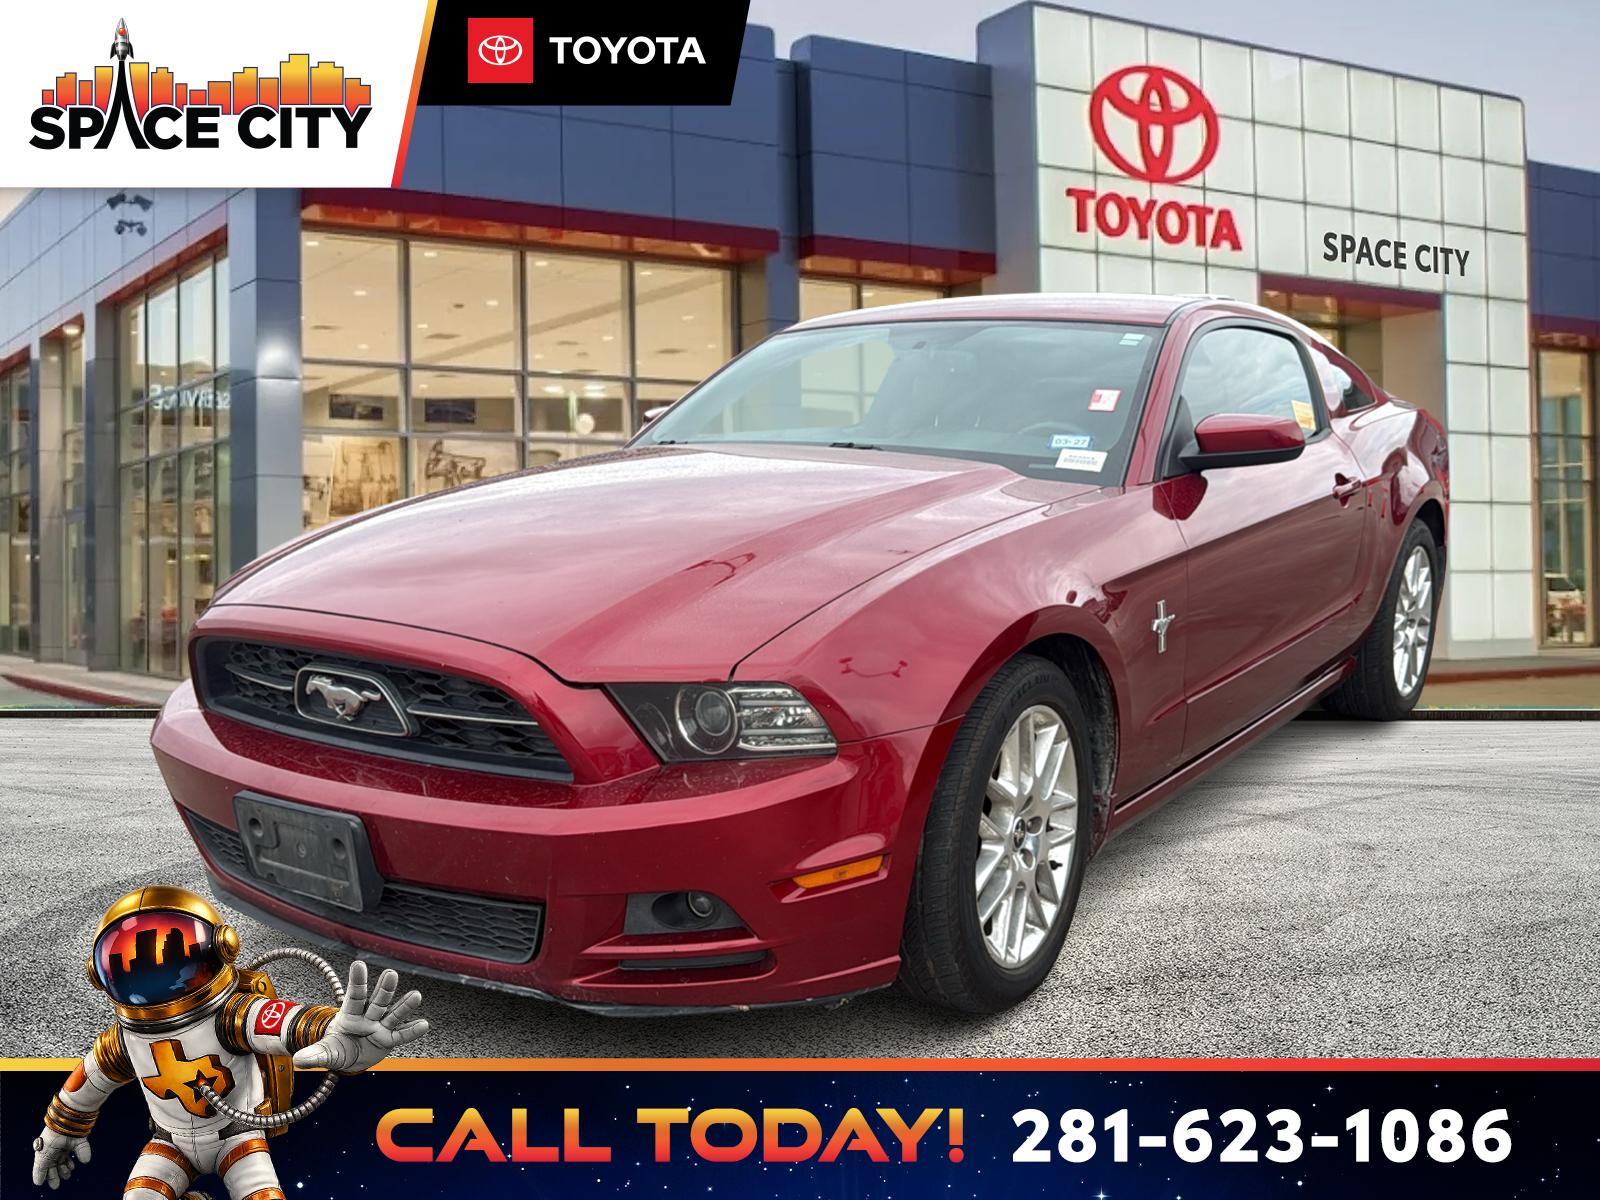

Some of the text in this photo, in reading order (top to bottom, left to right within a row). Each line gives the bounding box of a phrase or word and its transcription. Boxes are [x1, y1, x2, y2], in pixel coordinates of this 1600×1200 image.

[1066, 187, 1243, 251] TOYOTA
[1323, 232, 1470, 277] SPACE CITY
